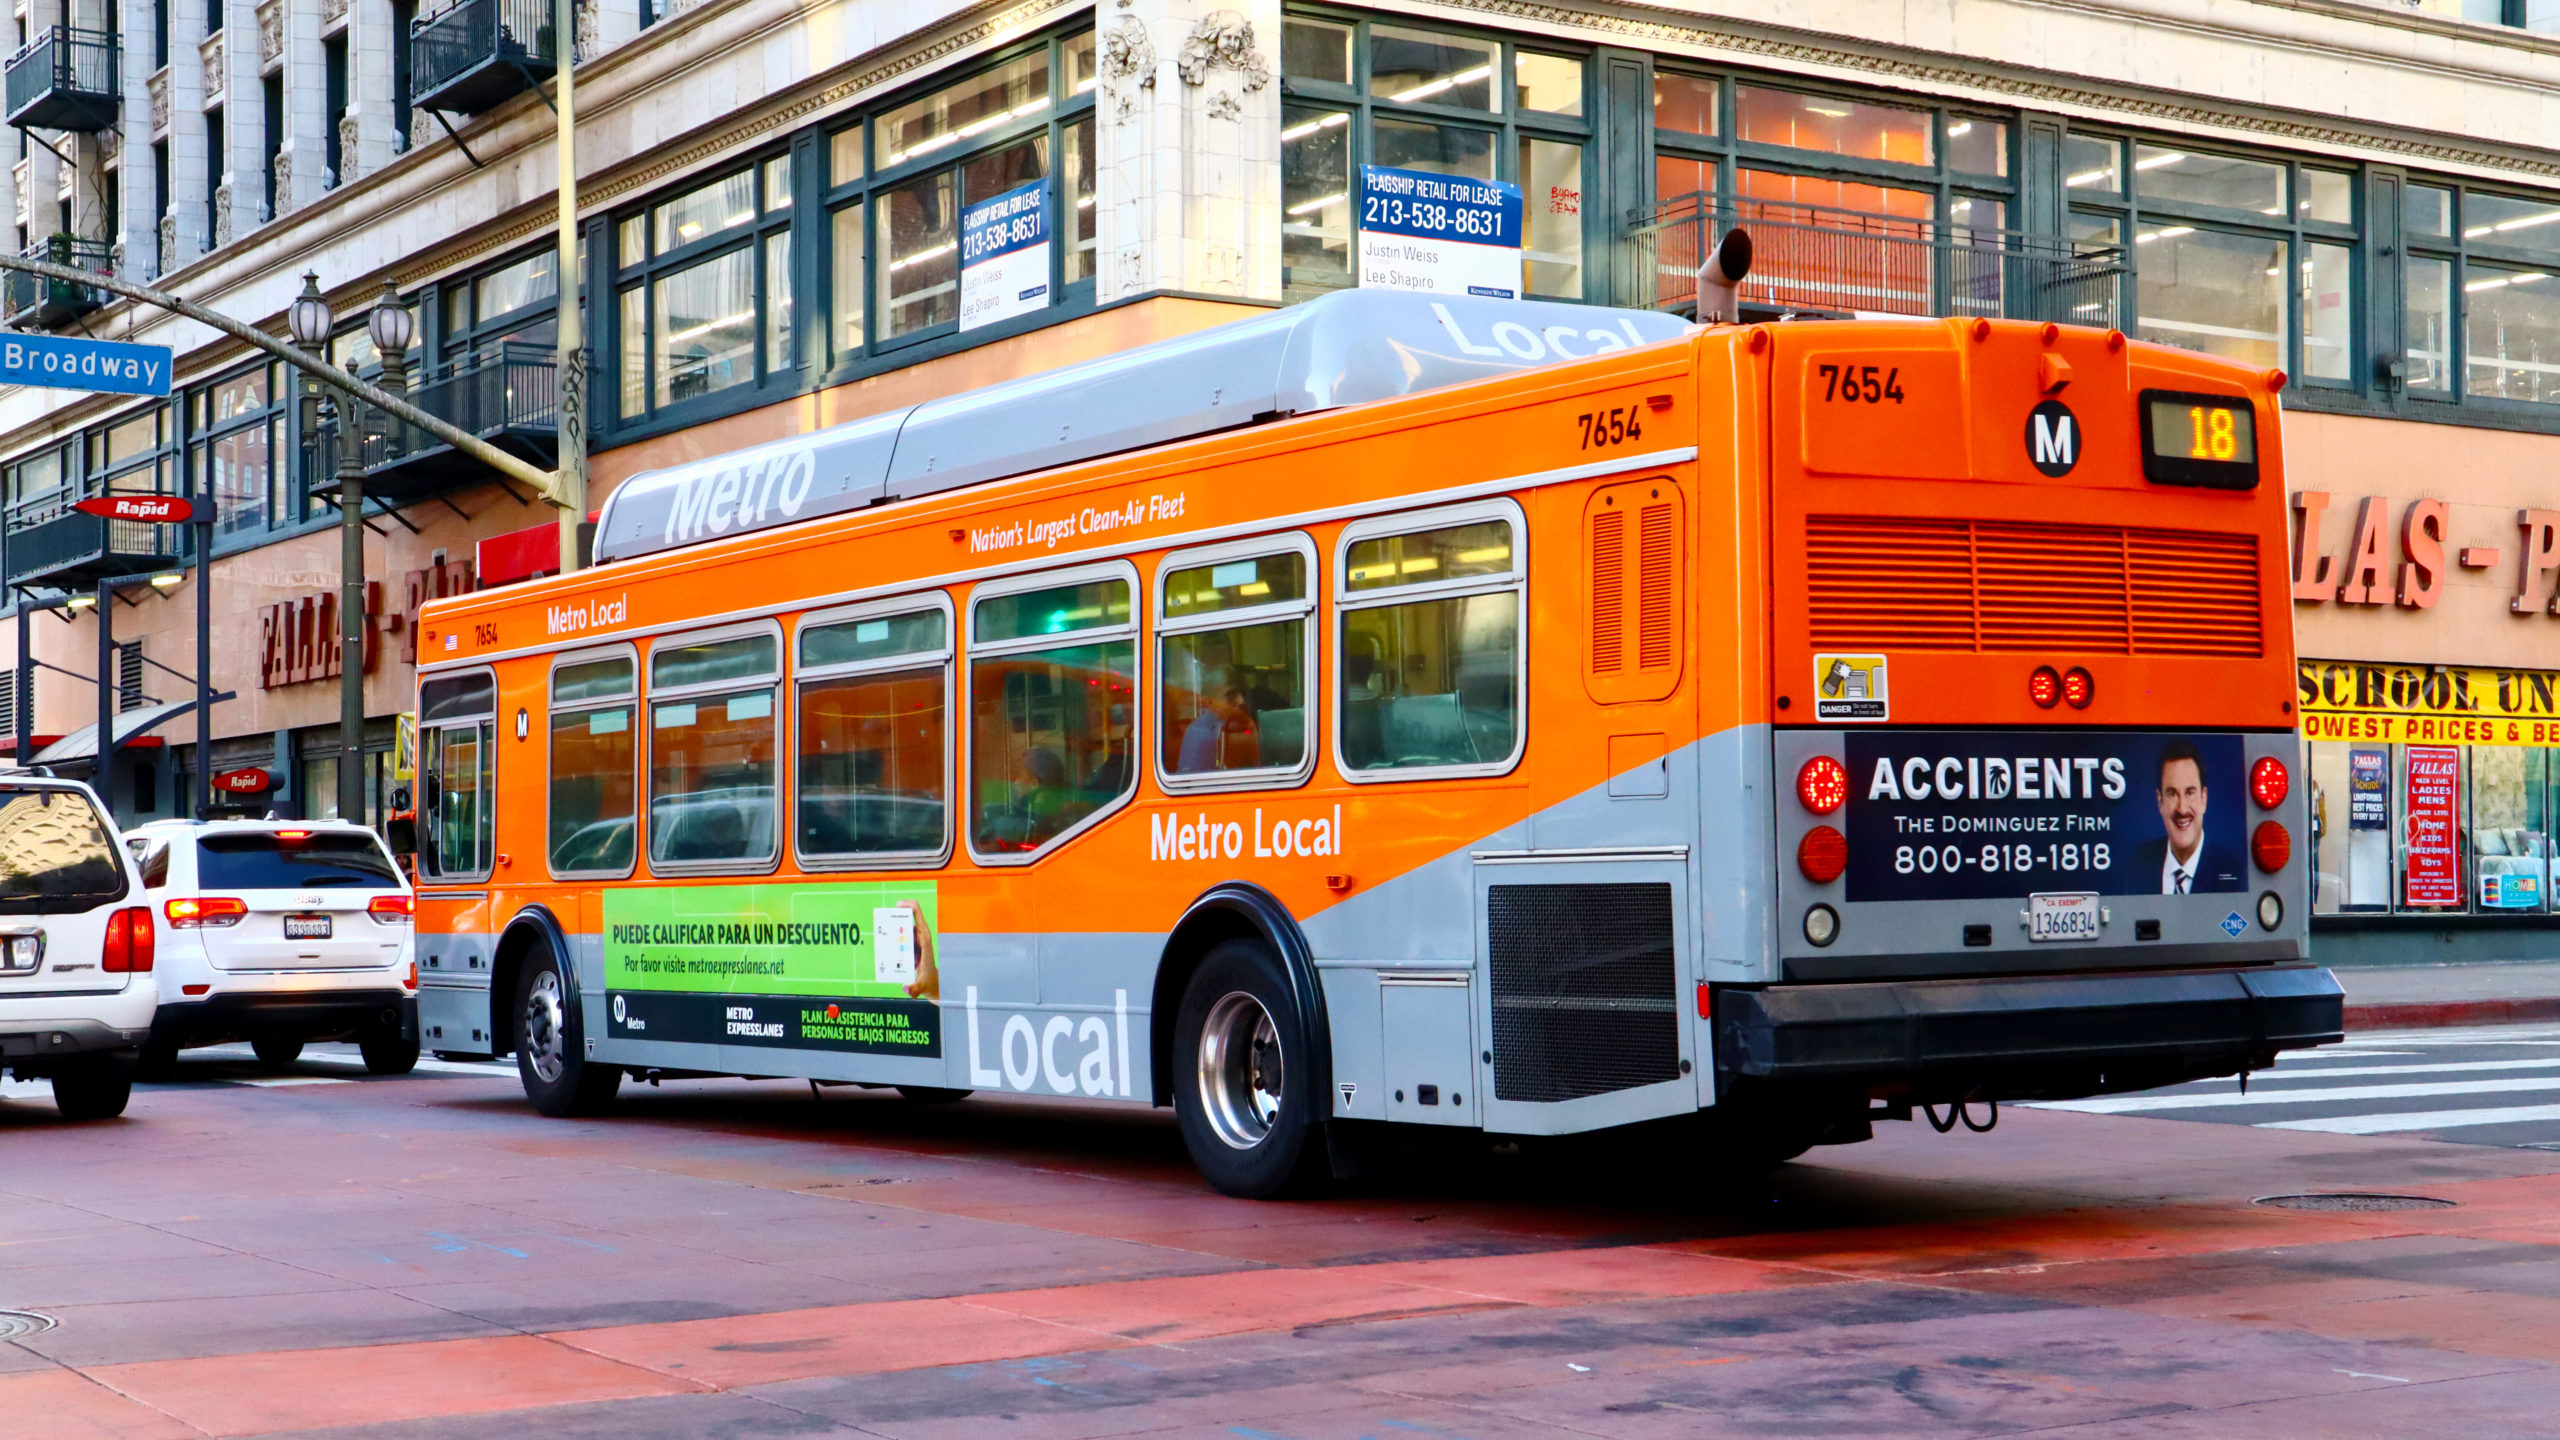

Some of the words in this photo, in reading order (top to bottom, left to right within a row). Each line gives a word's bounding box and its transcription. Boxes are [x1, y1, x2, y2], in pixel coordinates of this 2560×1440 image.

[1367, 174, 1414, 196] FLAGSHIP
[1416, 180, 1448, 200] RETAIL
[1451, 184, 1470, 202] FOR
[1472, 186, 1502, 206] LEASE
[964, 208, 990, 230] FLAGSHIP
[990, 201, 1008, 221] RETAIL
[1010, 196, 1022, 214] FOR
[1022, 189, 1040, 211] LEASE
[1366, 197, 1502, 236] 213-538-8631
[964, 212, 1040, 260] 213-538-8631
[1366, 242, 1400, 259] Justin
[1404, 246, 1438, 264] Weiss
[964, 273, 982, 292] Justin
[982, 269, 1002, 284] Weiss
[1366, 268, 1386, 284] Lee
[1390, 270, 1434, 290] Shapiro
[963, 303, 974, 318] Lee
[976, 295, 1000, 314] Shapiro
[5, 343, 159, 386] Broadway
[1820, 364, 1904, 404] 7654
[1578, 405, 1642, 450] 7654
[2190, 406, 2236, 460] 18
[2034, 414, 2072, 464] M
[665, 448, 815, 544] Metro
[116, 500, 170, 517] Rapid
[970, 521, 1023, 553] Nation's
[1027, 513, 1076, 548] Largest
[1080, 500, 1146, 534] Clean-Air
[1149, 492, 1185, 522] Fleet
[548, 606, 586, 634] Metro
[592, 593, 626, 627] Local
[476, 623, 498, 646] 7654
[2298, 662, 2479, 712] SCHOOL
[1821, 705, 1852, 714] DANGER
[517, 714, 528, 736] M
[2305, 716, 2393, 738] OWEST
[2406, 719, 2493, 741] PRICES
[2507, 723, 2519, 742] &
[2533, 723, 2560, 742] BE
[2354, 756, 2381, 764] FALLAS
[2411, 762, 2454, 774] FALLAS
[231, 776, 256, 788] Rapid
[1868, 757, 2126, 800] ACCIDENTS
[2353, 793, 2382, 802] UNIFORMS
[2412, 786, 2451, 795] LADIES
[2418, 796, 2446, 804] MENS
[2352, 803, 2364, 812] BEST
[2366, 803, 2383, 812] PRICES
[1150, 812, 1242, 861] Metro
[1254, 804, 1341, 858] Local
[2418, 822, 2446, 830] HOME
[1894, 842, 2110, 874] 800-818-1818
[2506, 880, 2535, 890] HOME
[2036, 912, 2094, 934] 1366834
[2225, 920, 2243, 930] CNG
[614, 924, 650, 945] PUEDE
[653, 924, 714, 945] CALIFICAR
[718, 924, 750, 945] PARA
[754, 924, 773, 944] UN
[778, 924, 864, 946] DESCUENTO.
[624, 956, 638, 972] Por
[640, 955, 660, 973] favor
[664, 956, 686, 974] visite
[688, 955, 784, 978] metroexpresslanes.net
[627, 1016, 646, 1030] Metro
[726, 1006, 753, 1021] METRO
[802, 1010, 822, 1024] PLAN
[836, 1011, 885, 1026] ASISTENCIA
[886, 1014, 910, 1028] PARA
[727, 1022, 784, 1038] EXPRESSLANES
[802, 1025, 844, 1040] PERSONAS
[846, 1028, 856, 1040] DE
[858, 1028, 884, 1045] BAJOS
[886, 1030, 930, 1045] INGRESOS
[967, 986, 1130, 1096] Local
